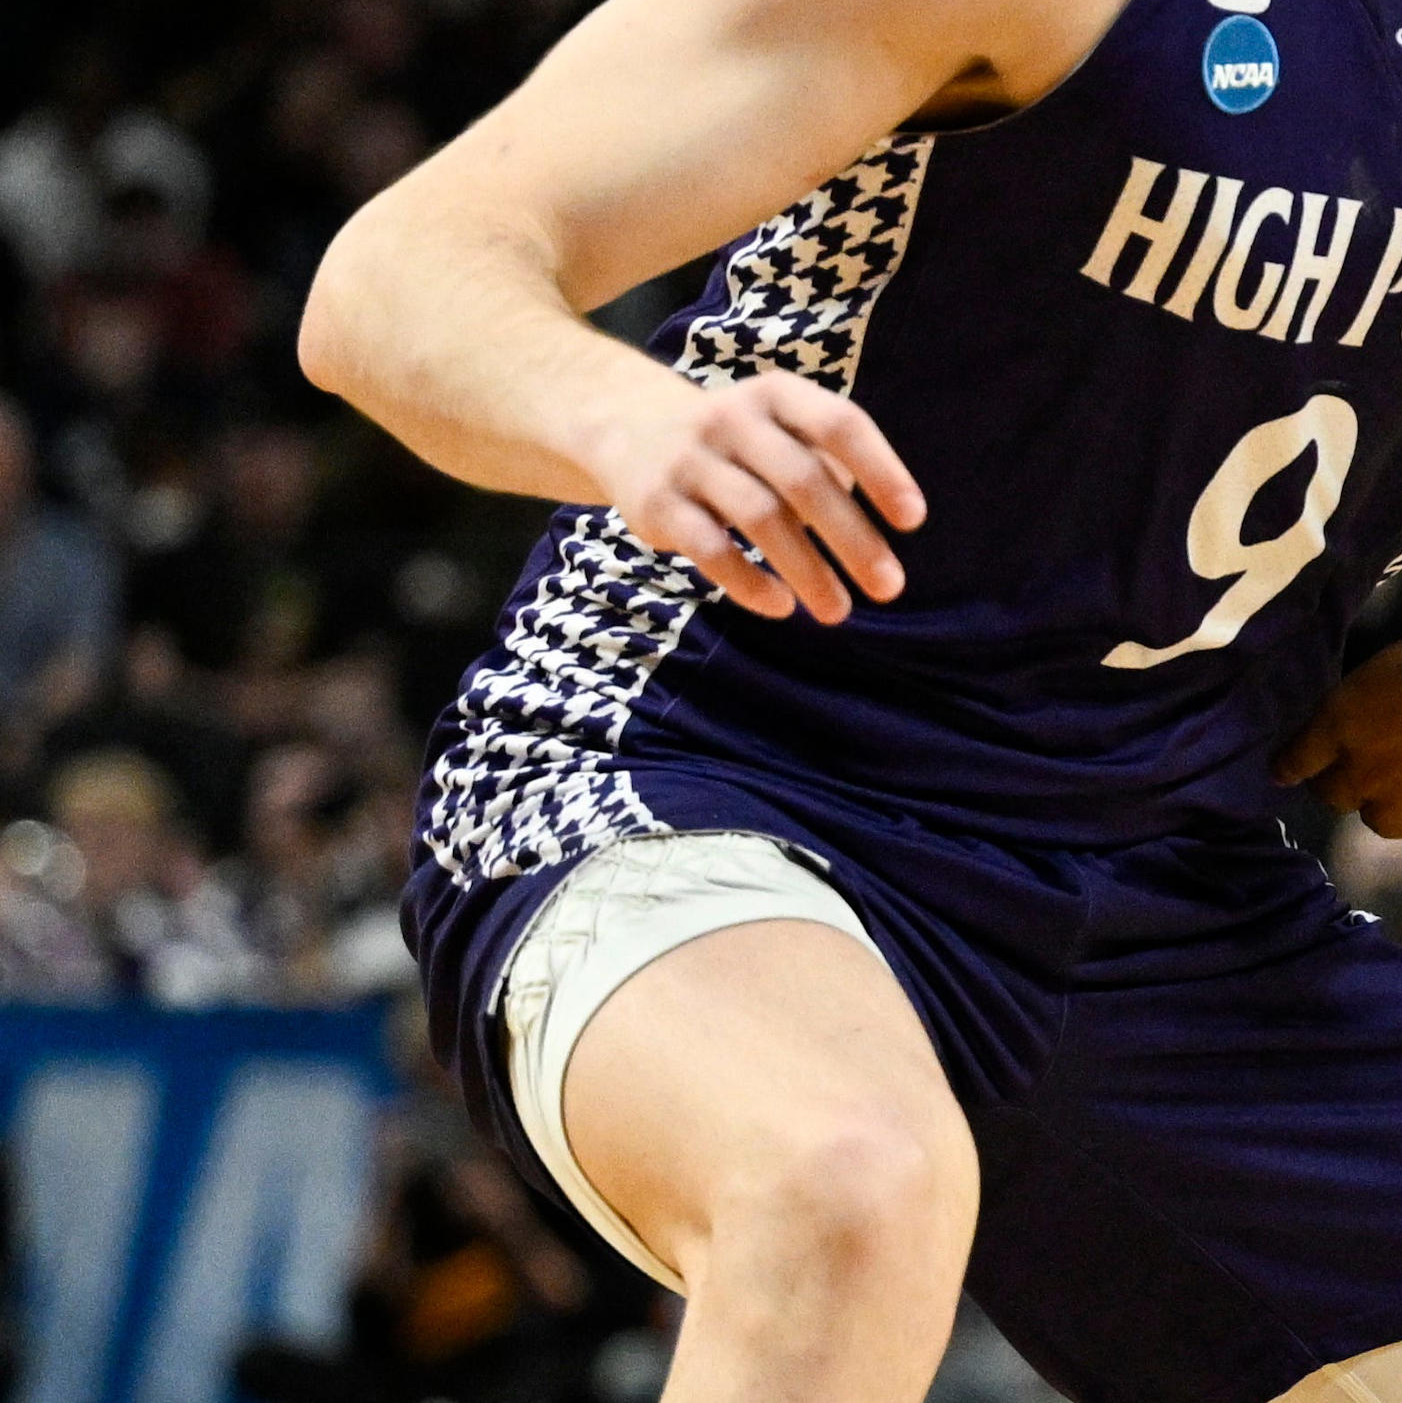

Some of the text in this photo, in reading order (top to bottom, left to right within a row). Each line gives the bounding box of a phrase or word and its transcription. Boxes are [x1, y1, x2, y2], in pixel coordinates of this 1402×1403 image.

[1211, 61, 1275, 90] NCAA
[1080, 155, 1363, 345] HIGH
[1101, 394, 1358, 669] 9
